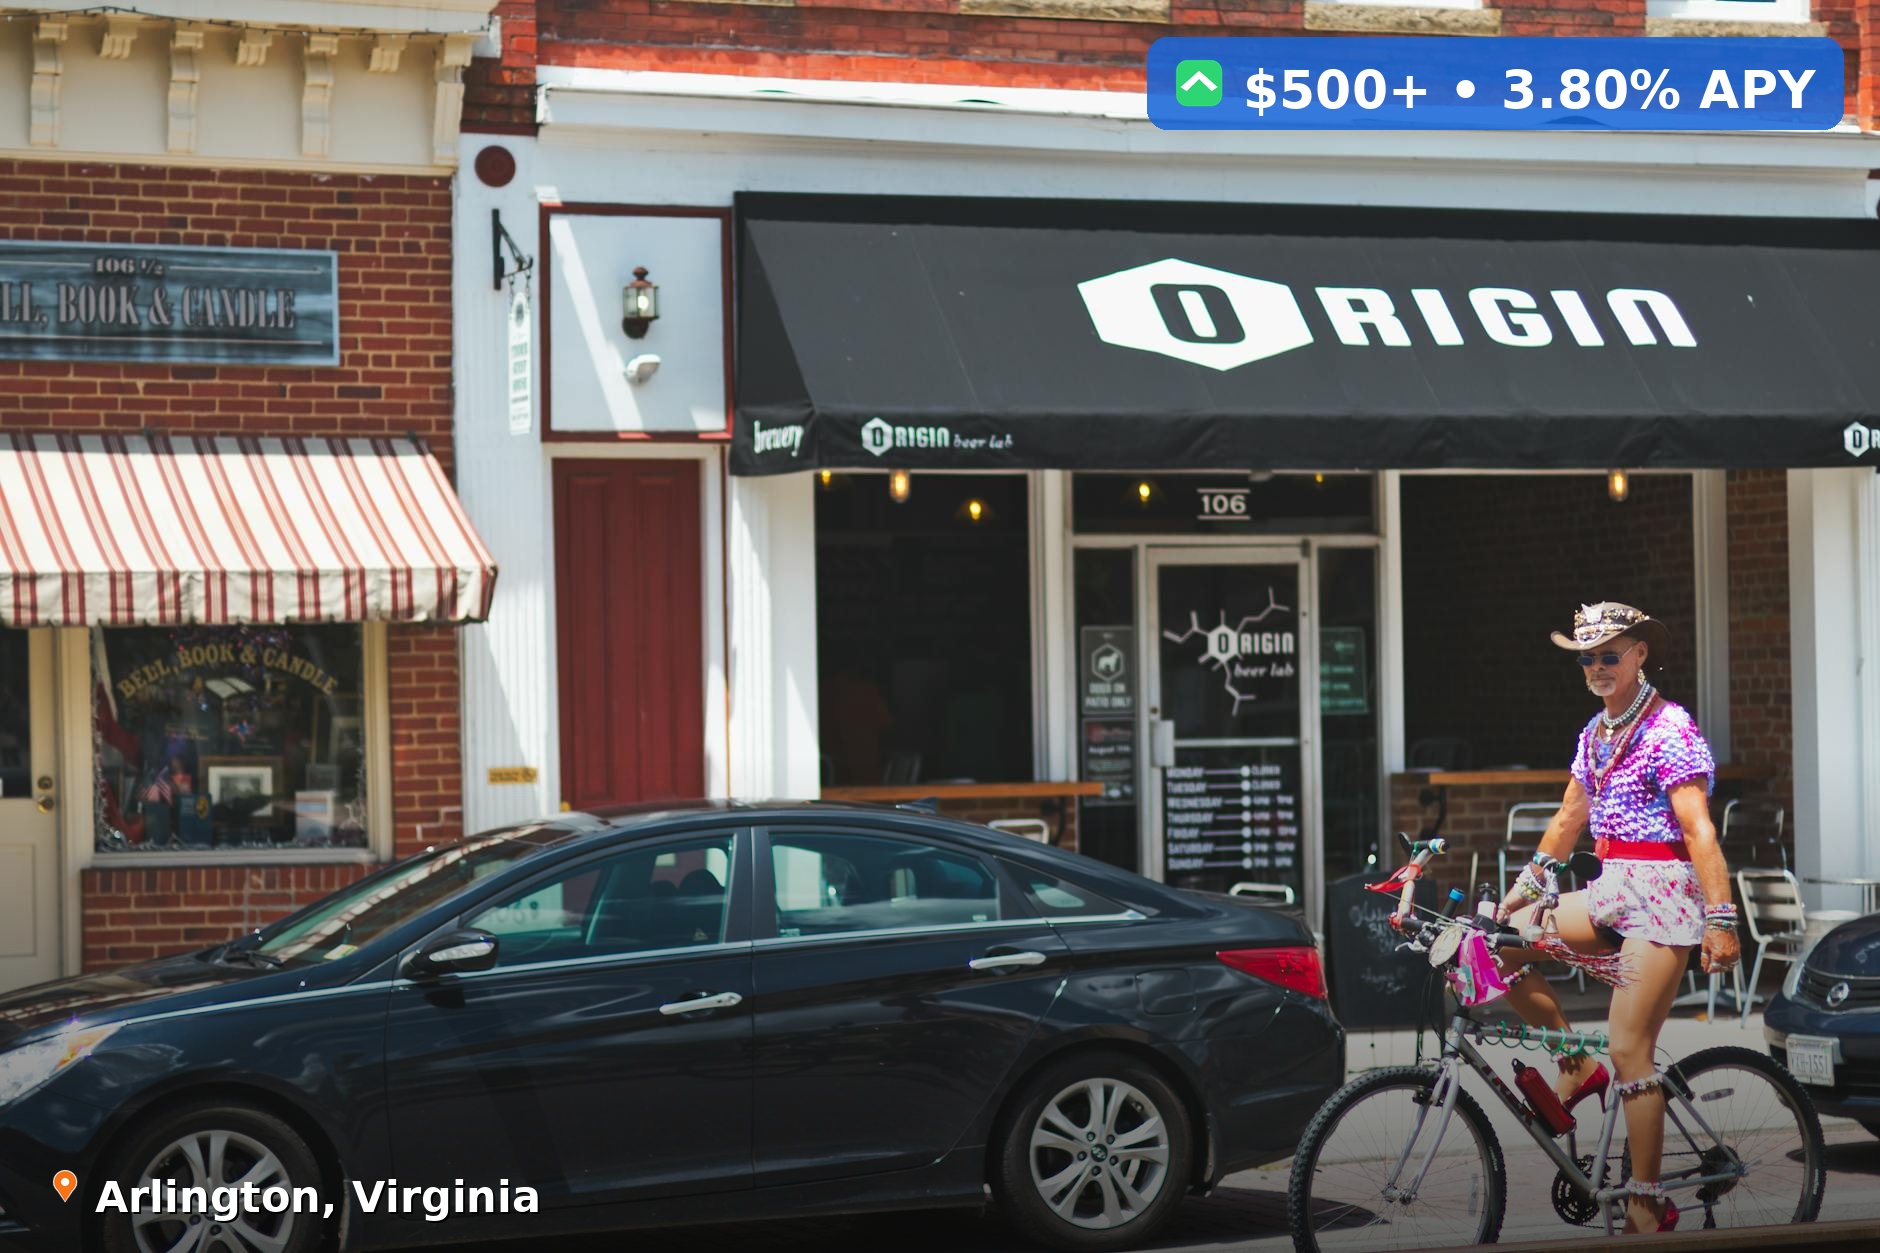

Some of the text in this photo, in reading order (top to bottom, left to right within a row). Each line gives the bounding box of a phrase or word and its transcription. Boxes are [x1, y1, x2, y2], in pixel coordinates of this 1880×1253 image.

[95, 257, 134, 274] 106
[57, 283, 140, 326] BOOK
[148, 285, 172, 326] &
[182, 286, 296, 329] CANDLE
[1145, 278, 1700, 352] ORIGIN
[868, 424, 1013, 449] ORIGIN beer lab
[1201, 494, 1247, 514] 106
[1216, 630, 1295, 656] ORIGIN
[177, 644, 235, 669] BOOK
[239, 645, 257, 664] &
[262, 646, 339, 696] CANDLE
[1233, 662, 1295, 678] beer lab
[1167, 781, 1207, 793] TUESDAY
[1167, 796, 1222, 809] WEDNESDAY
[1167, 812, 1214, 824] THURSDAY
[1167, 842, 1214, 855] SATURDAY
